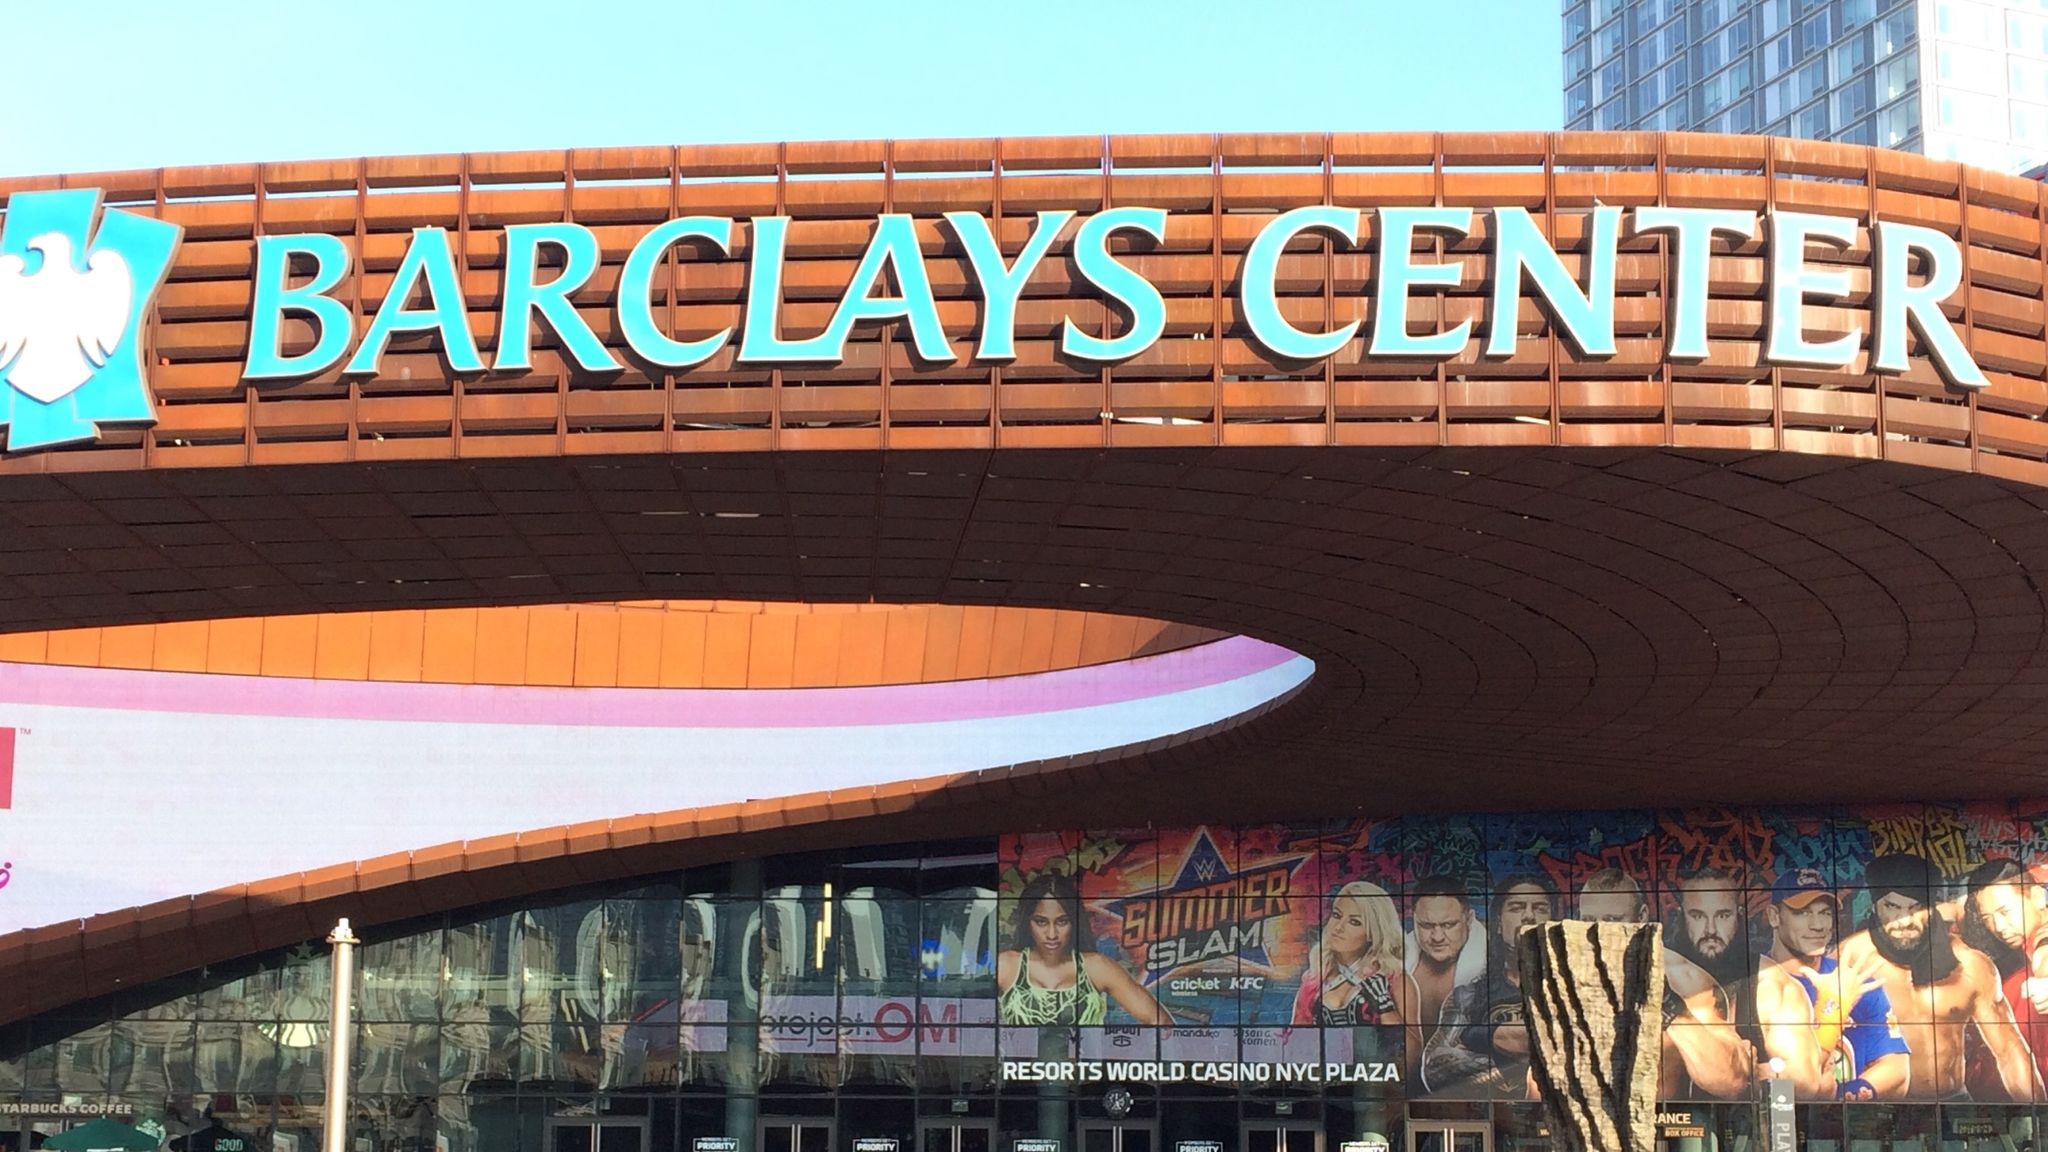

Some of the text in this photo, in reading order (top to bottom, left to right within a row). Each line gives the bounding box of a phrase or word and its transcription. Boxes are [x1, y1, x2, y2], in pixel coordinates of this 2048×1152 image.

[243, 204, 1992, 389] BARCLAYS CENTER
[1123, 868, 1291, 947] SUMMER
[1147, 920, 1262, 971] SLAM
[1170, 977, 1265, 990] cricket KFC
[1003, 1062, 1400, 1082] RESORTS WORLD CASINO NYC PLAZA
[0, 1103, 132, 1114] TARBUCKS COFFEE
[1776, 1122, 1791, 1152] PLA
[214, 1138, 243, 1151] GOOD
[696, 1141, 736, 1150] PRIORITY
[856, 1143, 896, 1152] PRIORITY
[1017, 1144, 1057, 1152] PRIORITY
